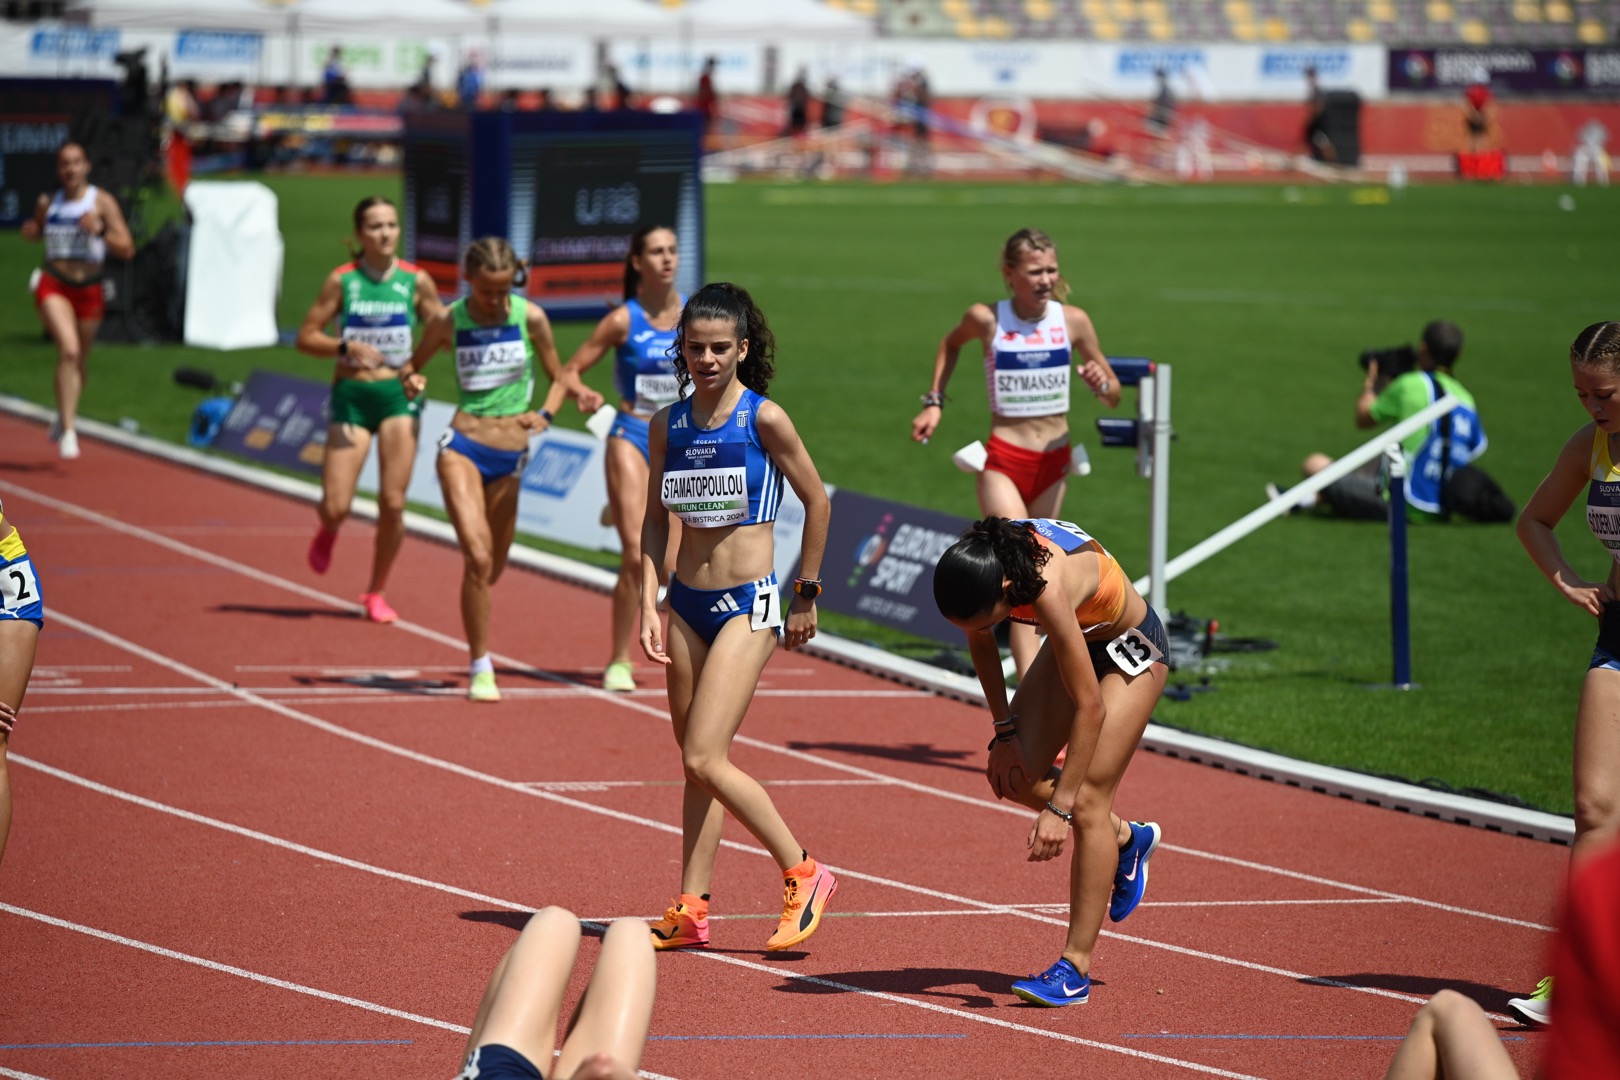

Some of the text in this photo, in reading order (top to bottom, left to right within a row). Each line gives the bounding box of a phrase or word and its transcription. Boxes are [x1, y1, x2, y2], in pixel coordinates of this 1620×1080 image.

[685, 447, 717, 457] SLOVAKIA
[663, 474, 743, 499] STAMATOPOULOU
[1600, 485, 1620, 493] SLOVA
[681, 503, 697, 511] RUN
[692, 515, 725, 523] BYSTRICA
[726, 512, 745, 521] 2024
[9, 570, 31, 601] 2
[759, 593, 771, 623] 7
[1115, 635, 1152, 669] 13
